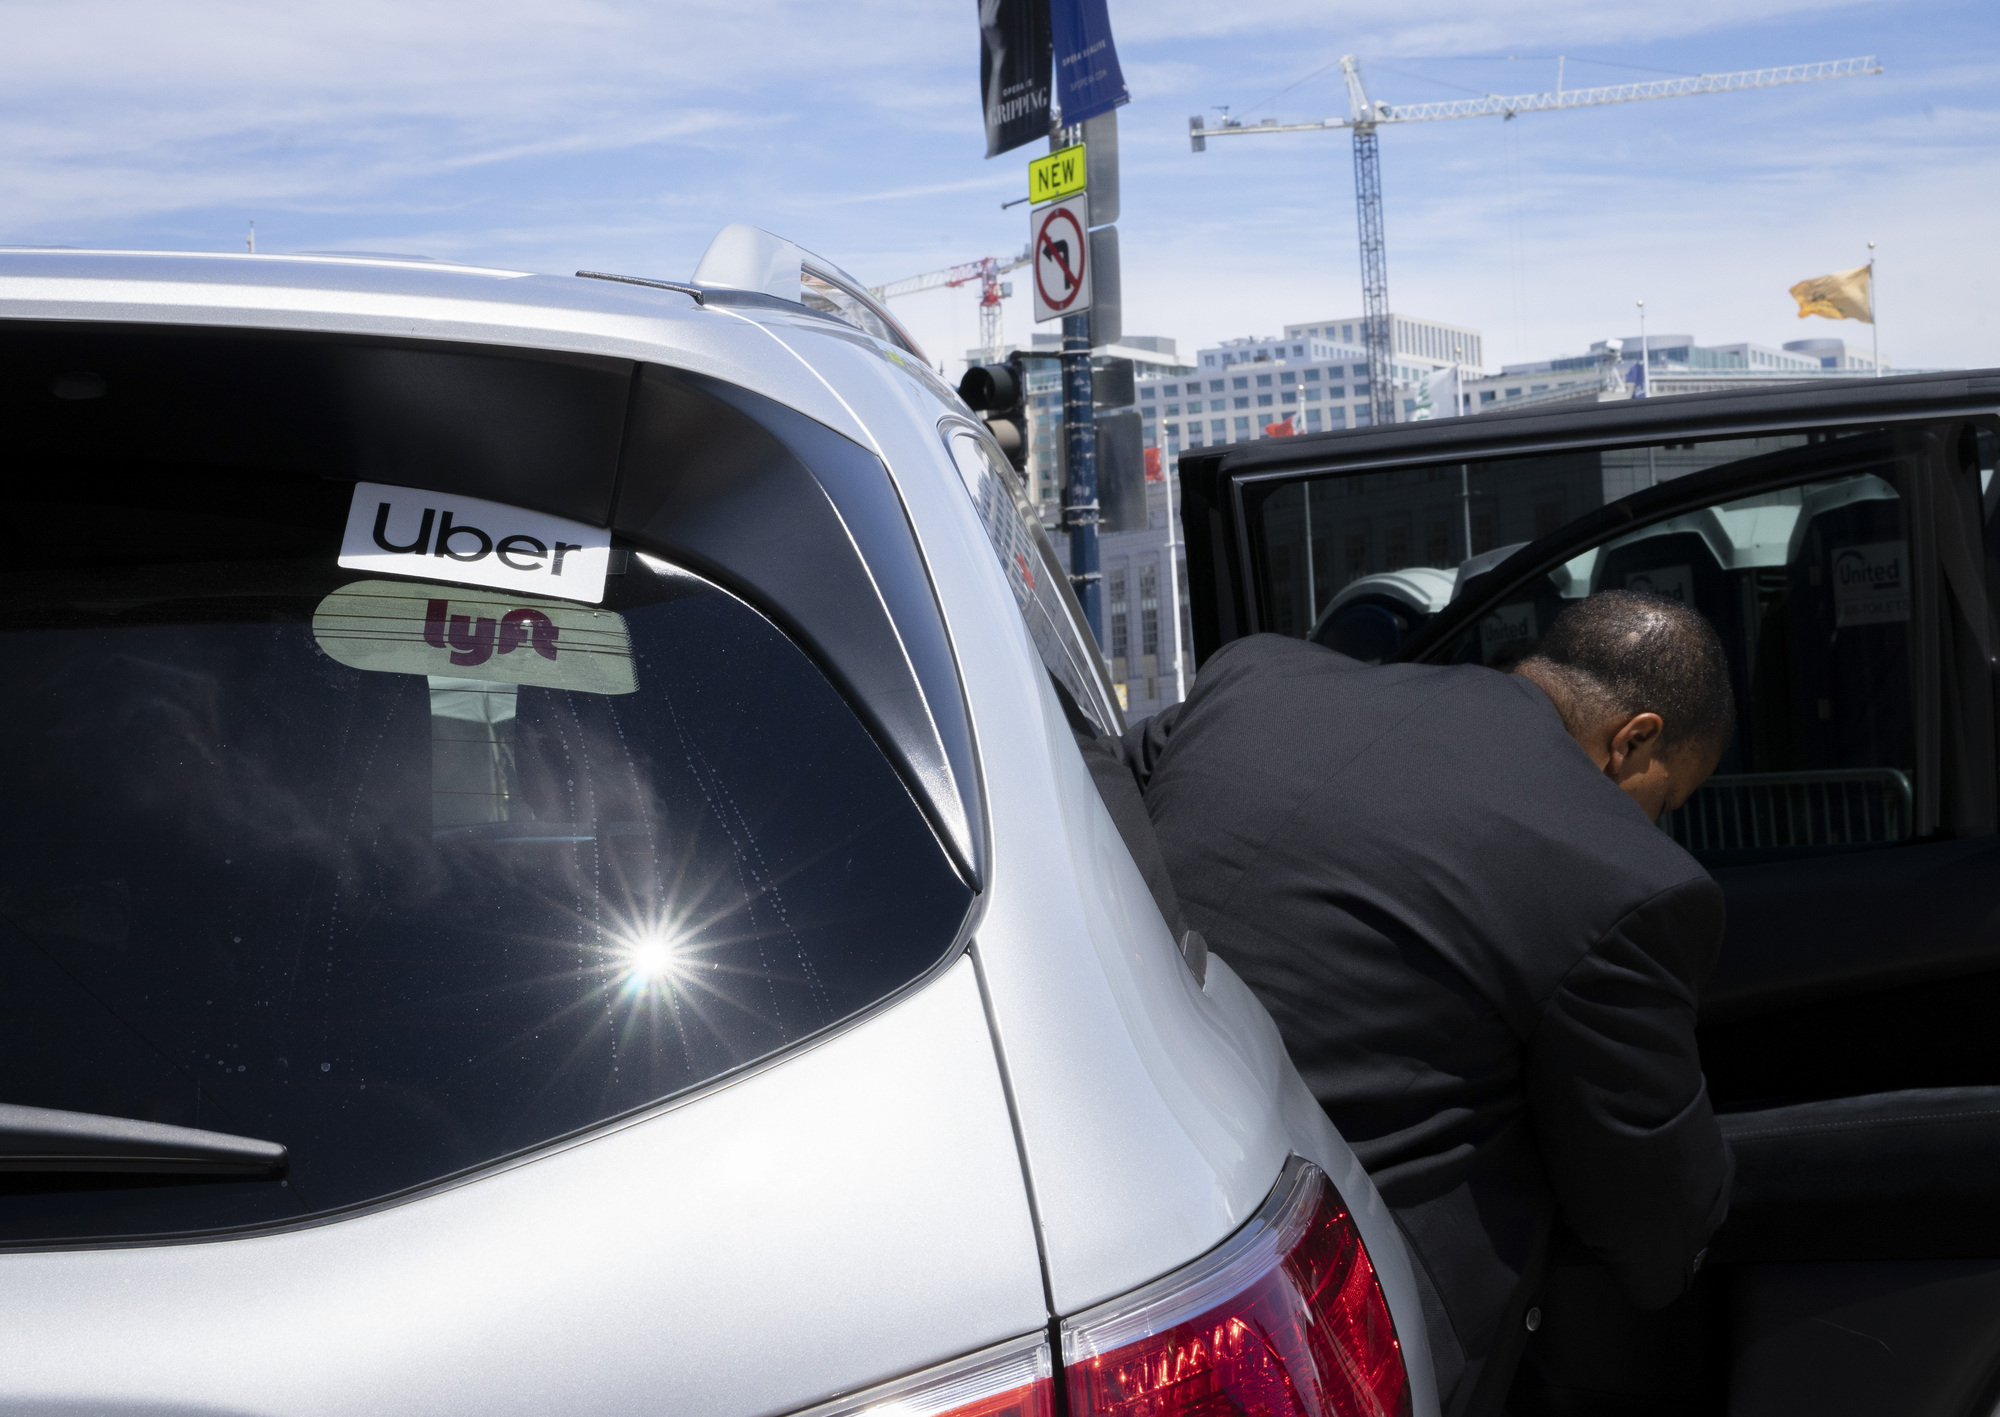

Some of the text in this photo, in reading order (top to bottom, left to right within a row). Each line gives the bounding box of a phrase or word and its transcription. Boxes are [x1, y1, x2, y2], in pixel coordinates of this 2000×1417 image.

[988, 87, 1048, 126] GRIPPING
[1002, 83, 1025, 97] OPERA
[1038, 157, 1075, 193] NEW
[373, 502, 582, 577] Uber
[1840, 558, 1899, 585] United
